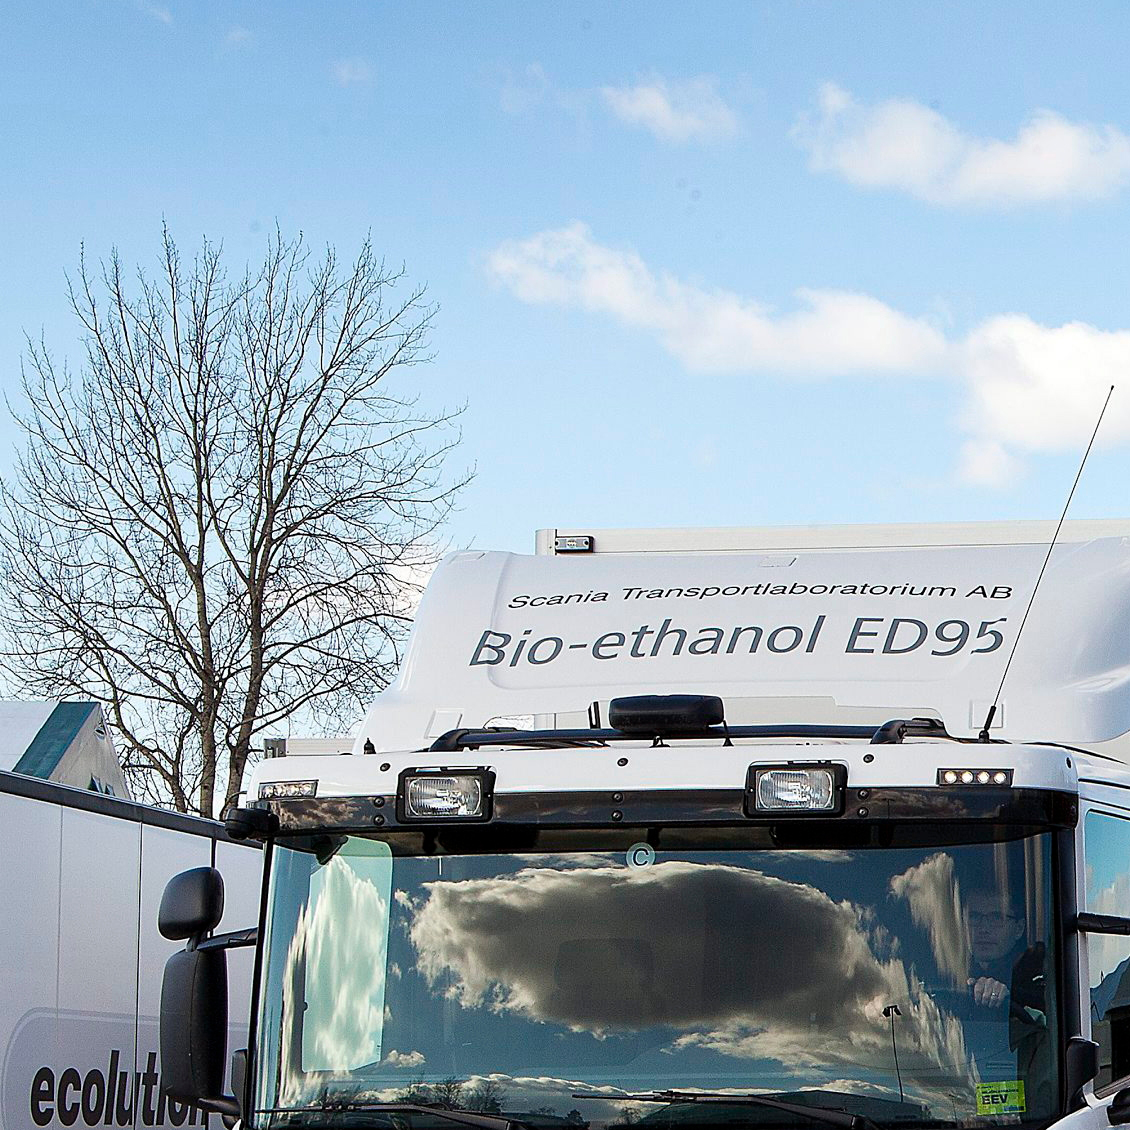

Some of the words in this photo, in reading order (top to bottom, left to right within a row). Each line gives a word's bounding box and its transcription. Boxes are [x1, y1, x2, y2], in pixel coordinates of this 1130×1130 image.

[508, 590, 609, 609] Scania
[622, 583, 957, 600] Transportlaboratorium
[965, 585, 1013, 600] AB
[468, 618, 826, 668] Bio-ethanol
[844, 616, 1008, 657] ED95
[981, 1094, 1008, 1105] EEV
